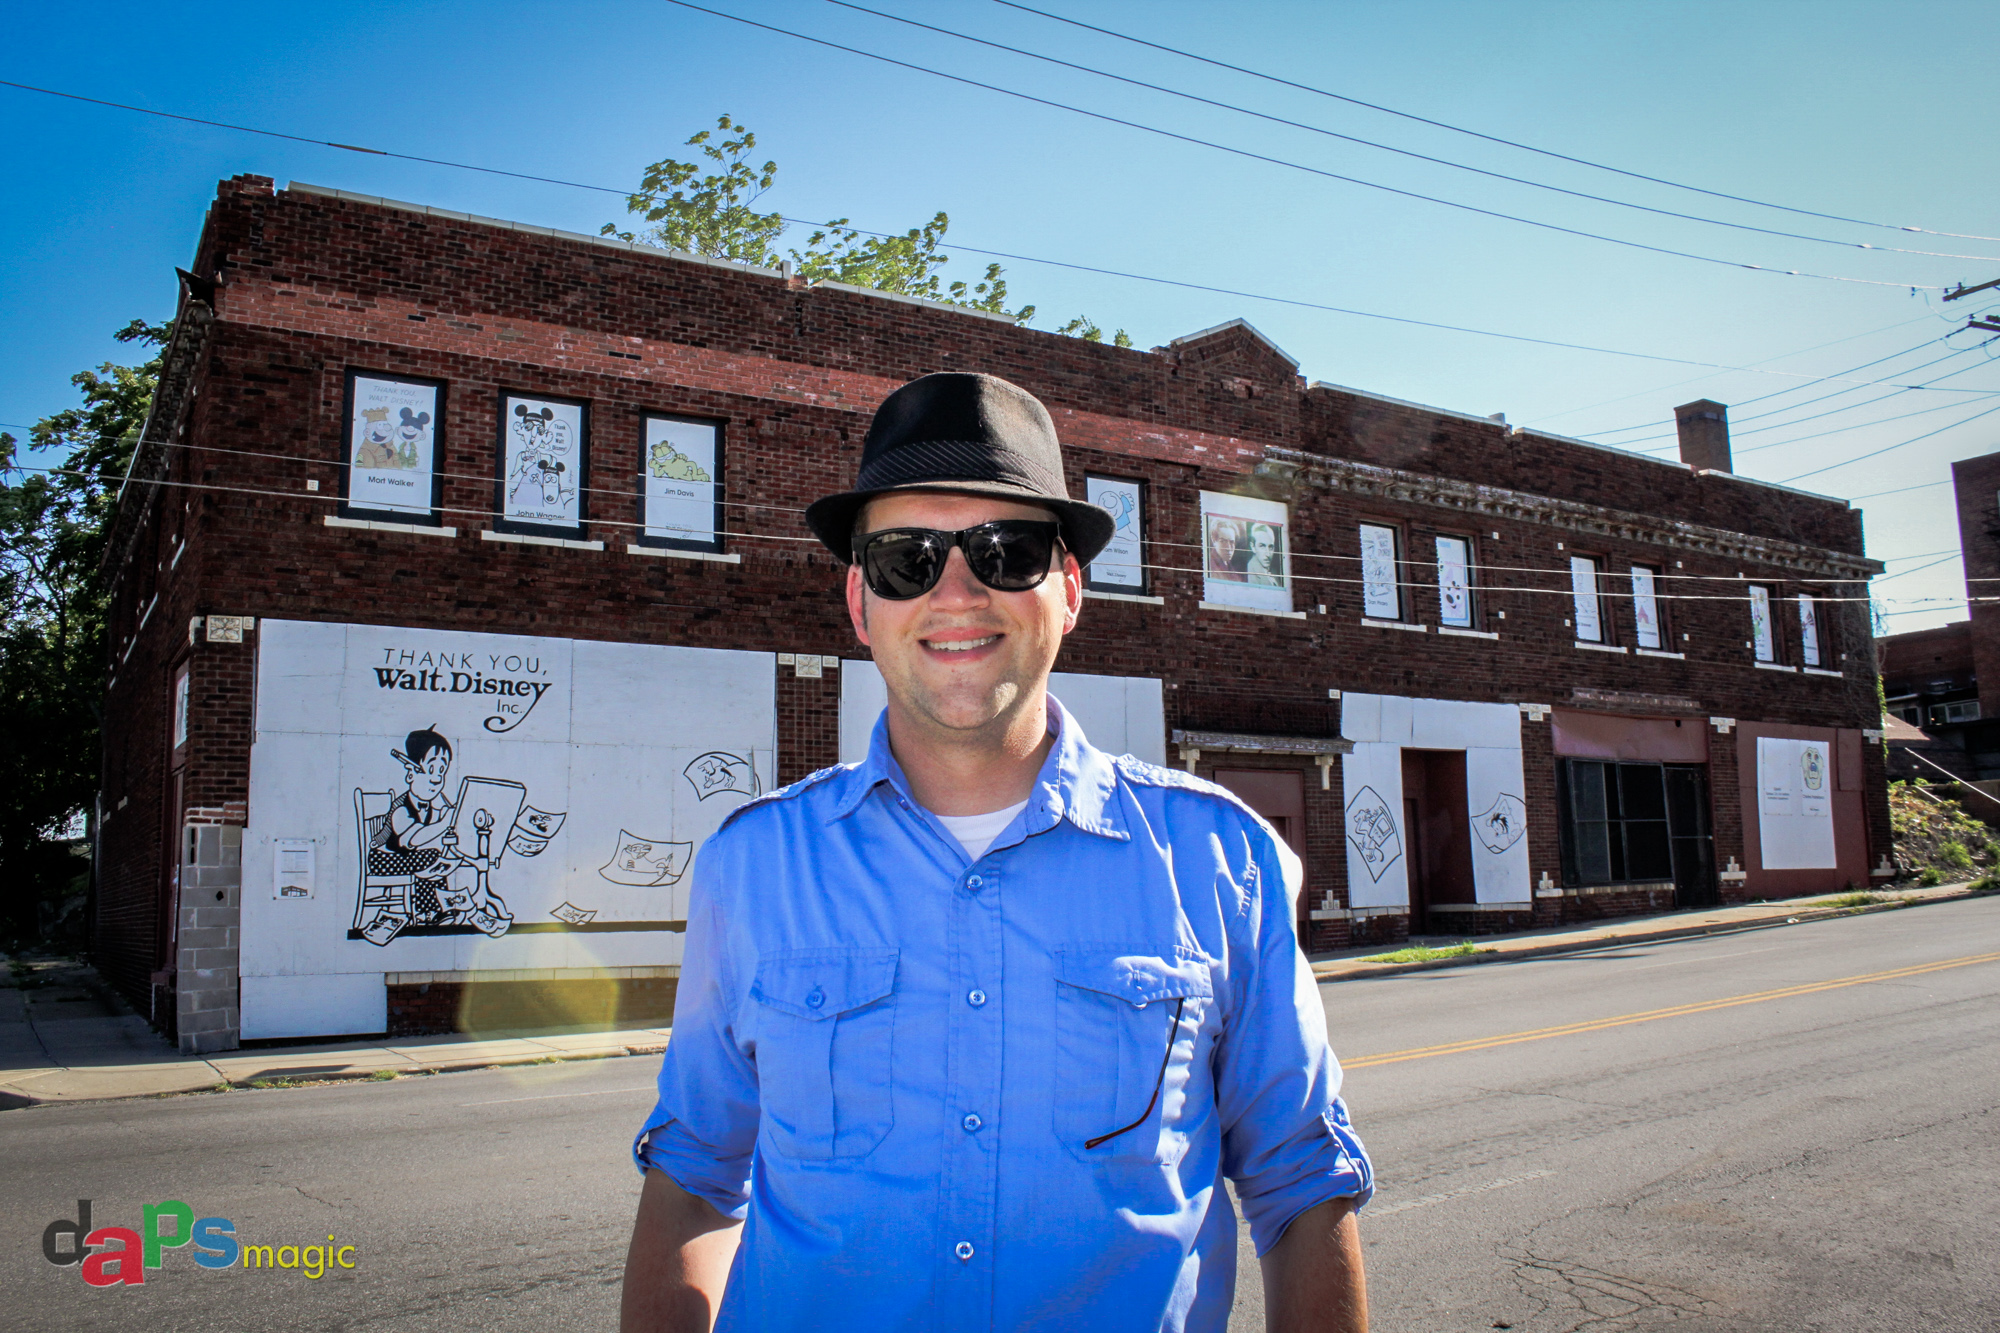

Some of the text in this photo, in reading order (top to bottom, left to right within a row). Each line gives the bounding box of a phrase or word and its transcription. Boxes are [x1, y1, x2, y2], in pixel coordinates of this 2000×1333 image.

[369, 394, 388, 402] WALT
[368, 475, 414, 487] Mort Walker
[677, 489, 695, 497] Davis
[516, 510, 535, 518] John
[384, 648, 547, 676] THANK YOU,
[496, 698, 523, 714] Inc.
